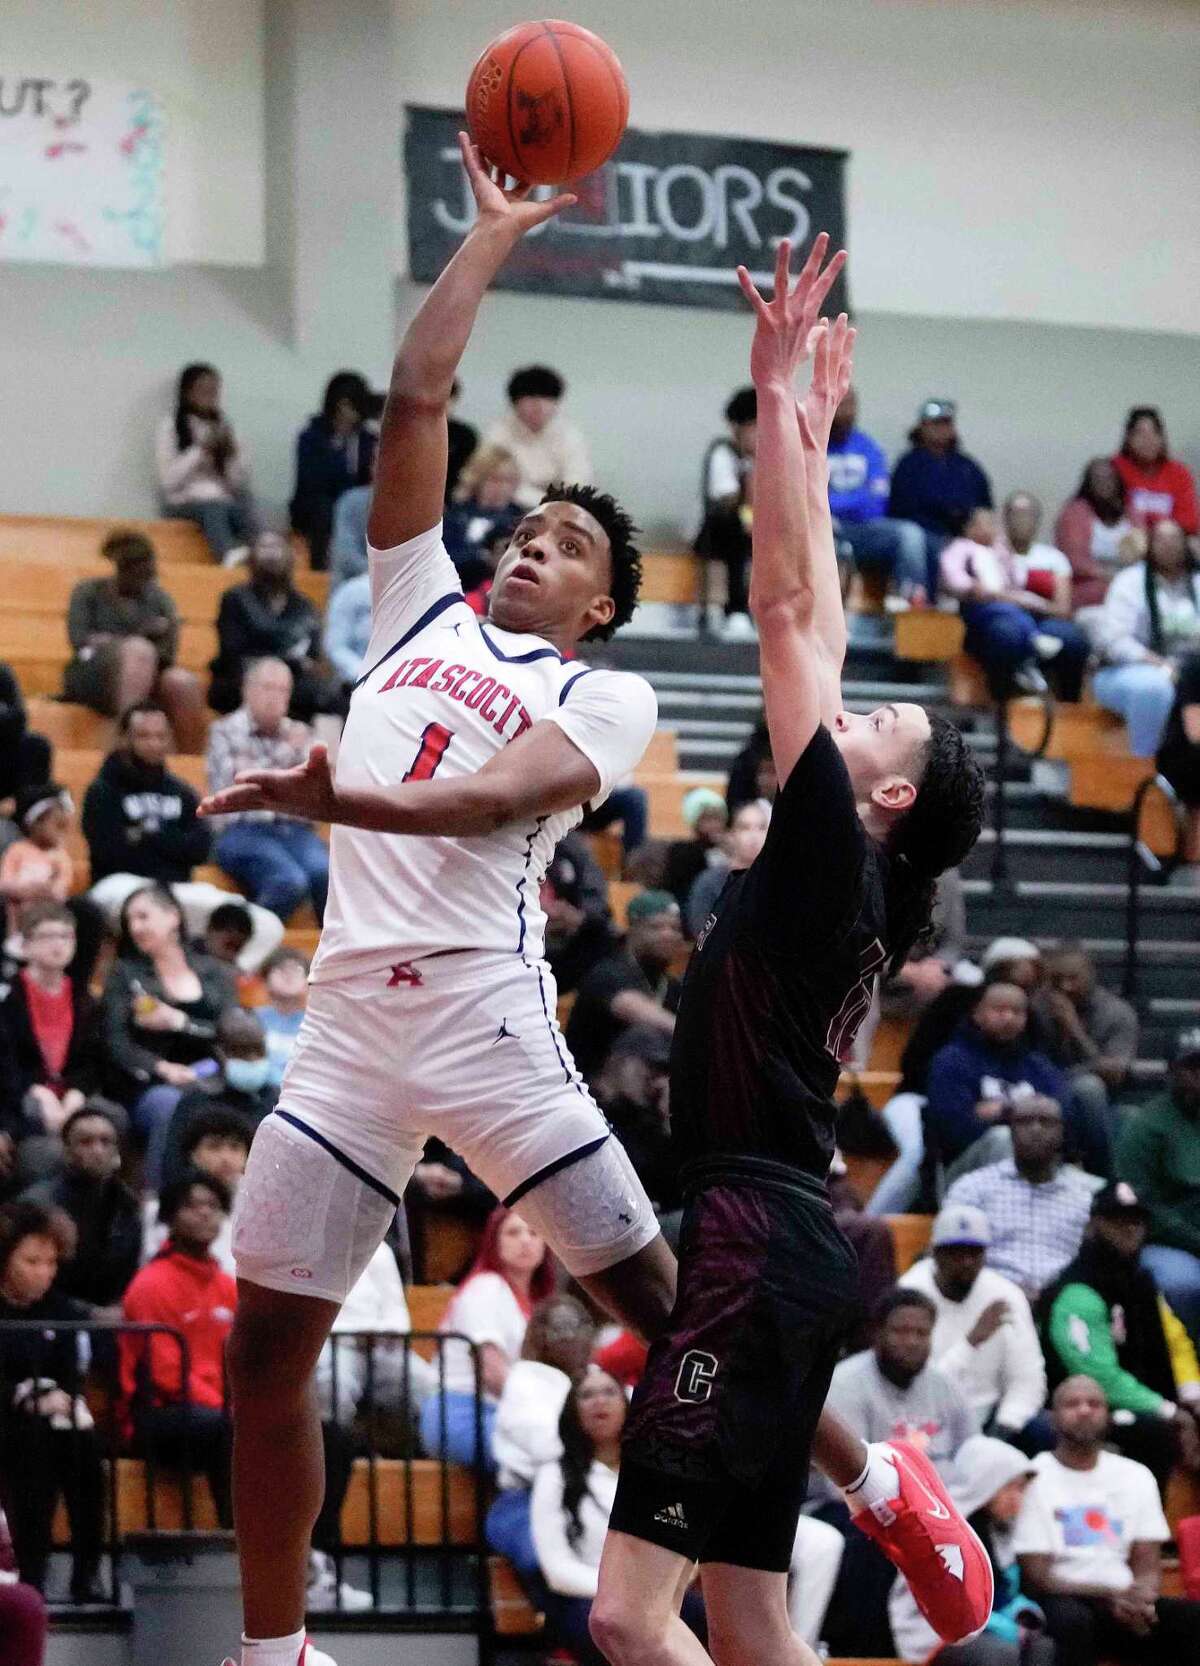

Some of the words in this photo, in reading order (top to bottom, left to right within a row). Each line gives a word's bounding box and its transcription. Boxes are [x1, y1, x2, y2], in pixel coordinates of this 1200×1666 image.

[434, 147, 812, 250] JIORS
[401, 722, 456, 783] 1
[674, 1349, 719, 1403] C
